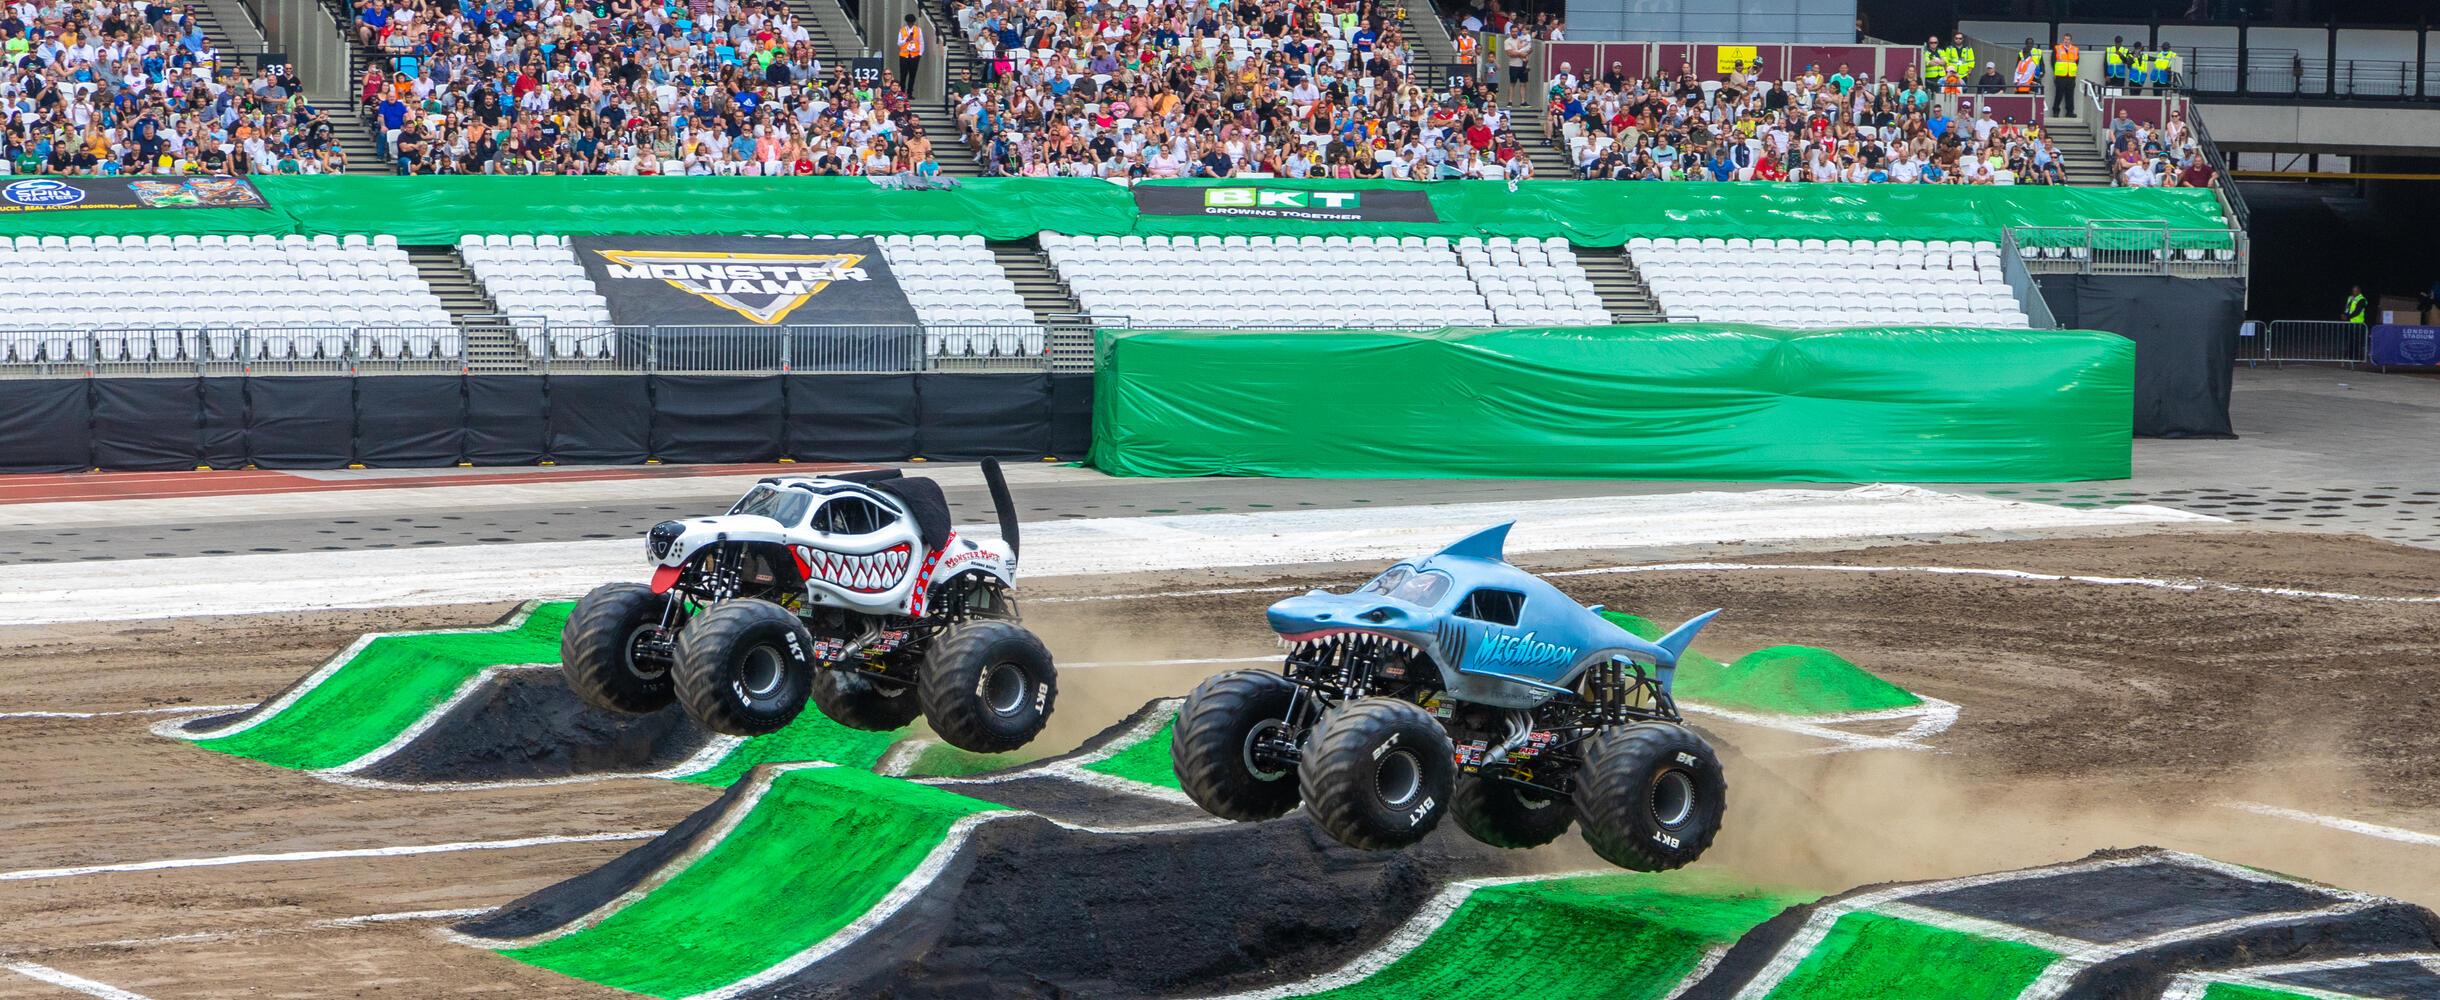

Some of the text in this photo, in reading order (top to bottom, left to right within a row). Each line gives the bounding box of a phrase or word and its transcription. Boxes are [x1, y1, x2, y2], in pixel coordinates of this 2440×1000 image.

[266, 64, 284, 76] 33
[854, 68, 879, 80] 132
[1448, 76, 1465, 87] 13
[15, 189, 72, 197] SPIN
[1207, 188, 1356, 208] BKT
[1205, 206, 1362, 220] GROWING TOGETHER
[604, 263, 872, 281] MONSTER
[690, 278, 809, 295] JAM
[785, 631, 805, 662] BKT
[1473, 628, 1578, 668] MEGALODON
[1035, 682, 1049, 716] BKT
[1372, 732, 1400, 761] BKT
[1675, 751, 1698, 767] BK
[1409, 796, 1436, 827] BKT
[1652, 830, 1681, 849] BKT
